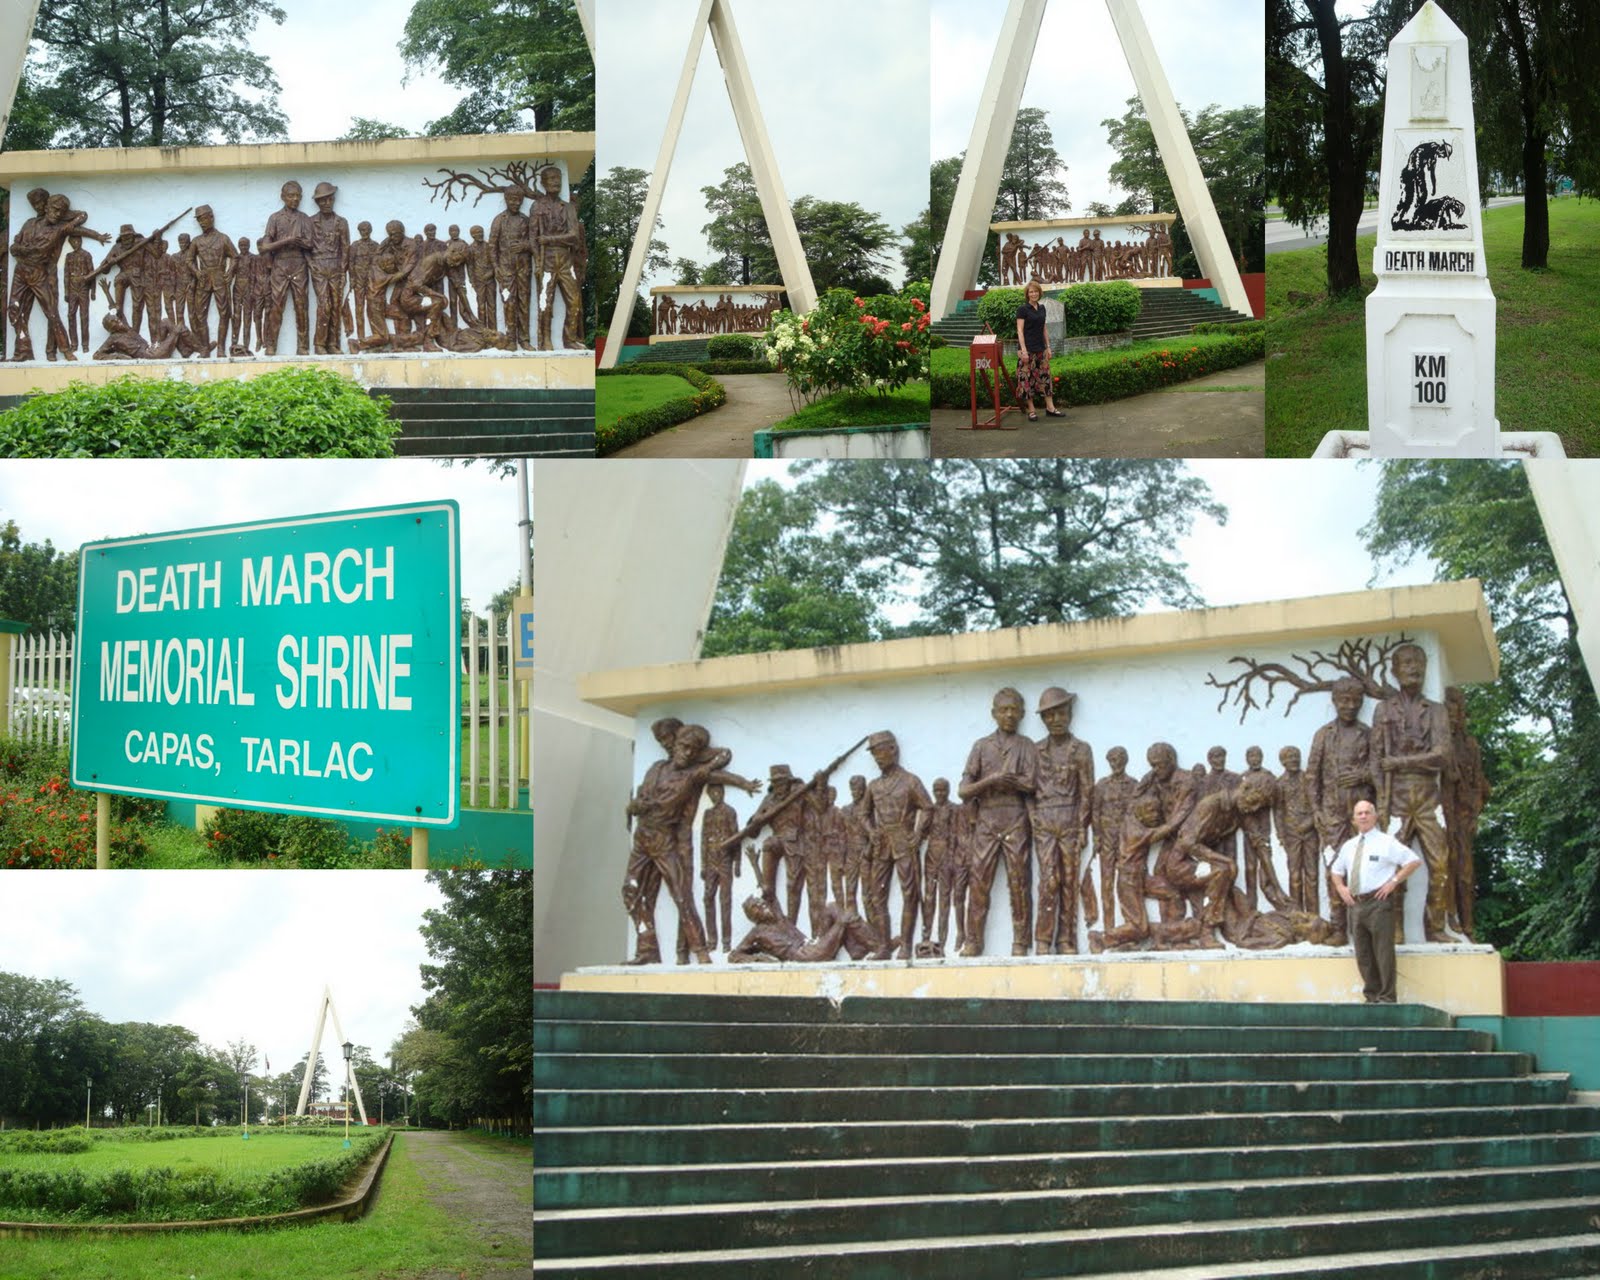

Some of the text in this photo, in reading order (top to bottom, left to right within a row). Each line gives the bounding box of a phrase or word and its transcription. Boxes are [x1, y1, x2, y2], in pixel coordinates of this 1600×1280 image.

[1385, 251, 1475, 272] DEATH MARCH
[1414, 355, 1446, 378] KM
[1414, 380, 1446, 404] 100
[116, 545, 395, 614] DEATH MARCH
[100, 633, 413, 711] MEMORIAL SHRINE
[125, 729, 374, 782] CAPAS, TARLAC
